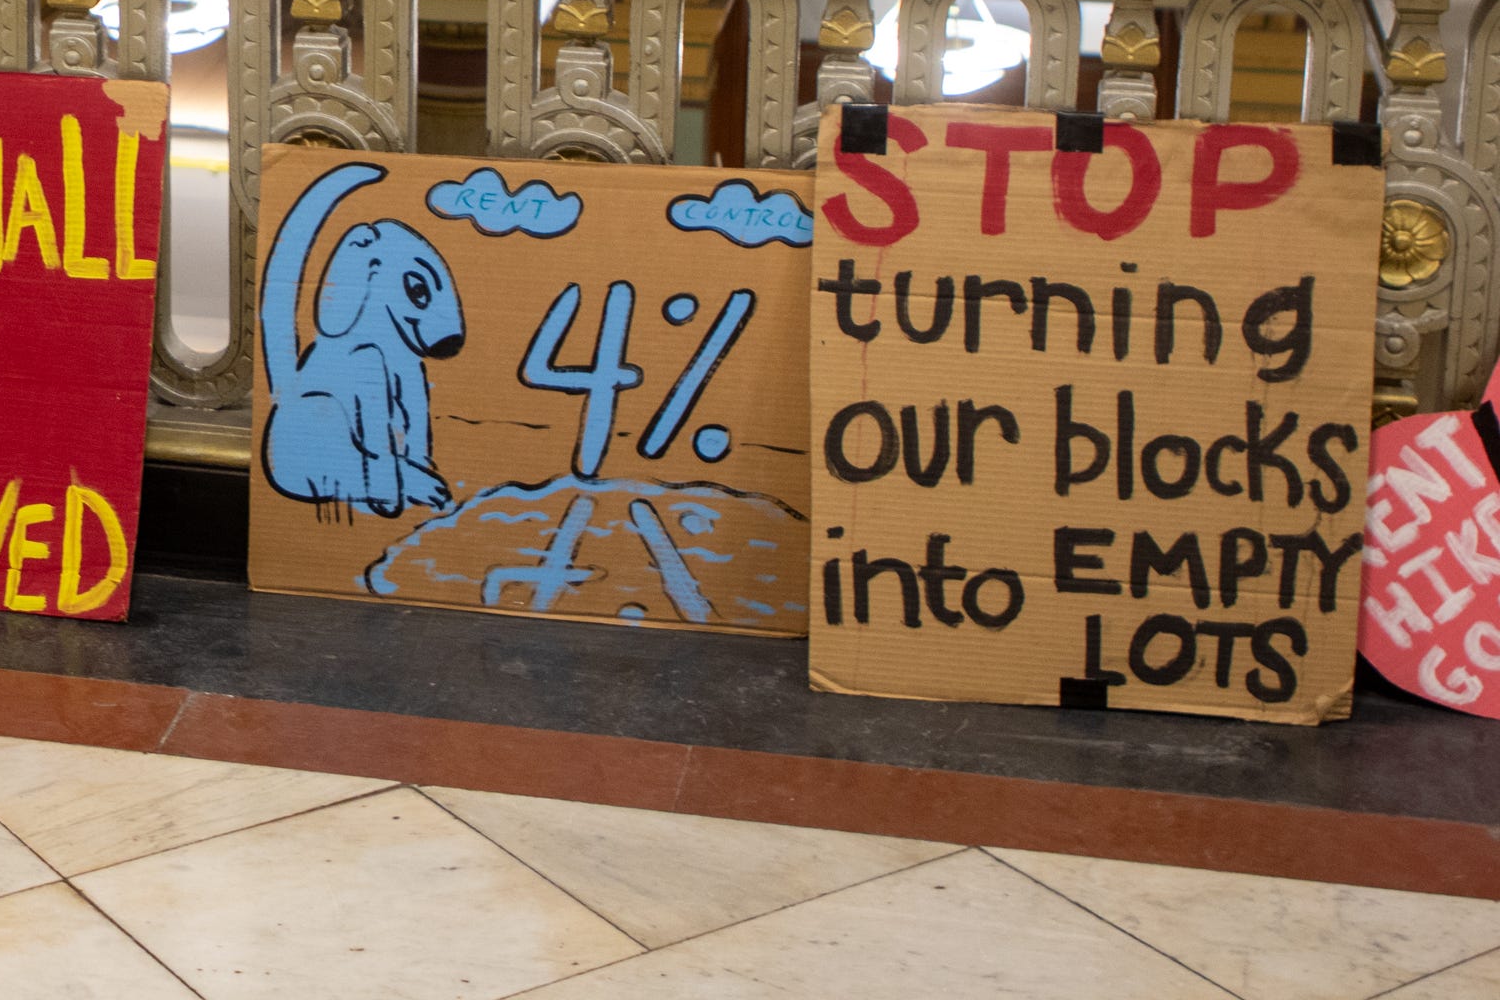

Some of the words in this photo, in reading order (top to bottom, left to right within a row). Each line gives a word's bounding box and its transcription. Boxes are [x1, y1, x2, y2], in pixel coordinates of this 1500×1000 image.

[454, 188, 548, 219] RENT
[684, 203, 813, 231] CONTROL
[820, 112, 1300, 247] STOP
[817, 258, 1315, 383] turning
[517, 280, 758, 479] 4%
[823, 400, 1020, 488] our
[822, 525, 1026, 628] into
[1053, 526, 1364, 613] EMPTY
[1085, 613, 1308, 703] LOTS
